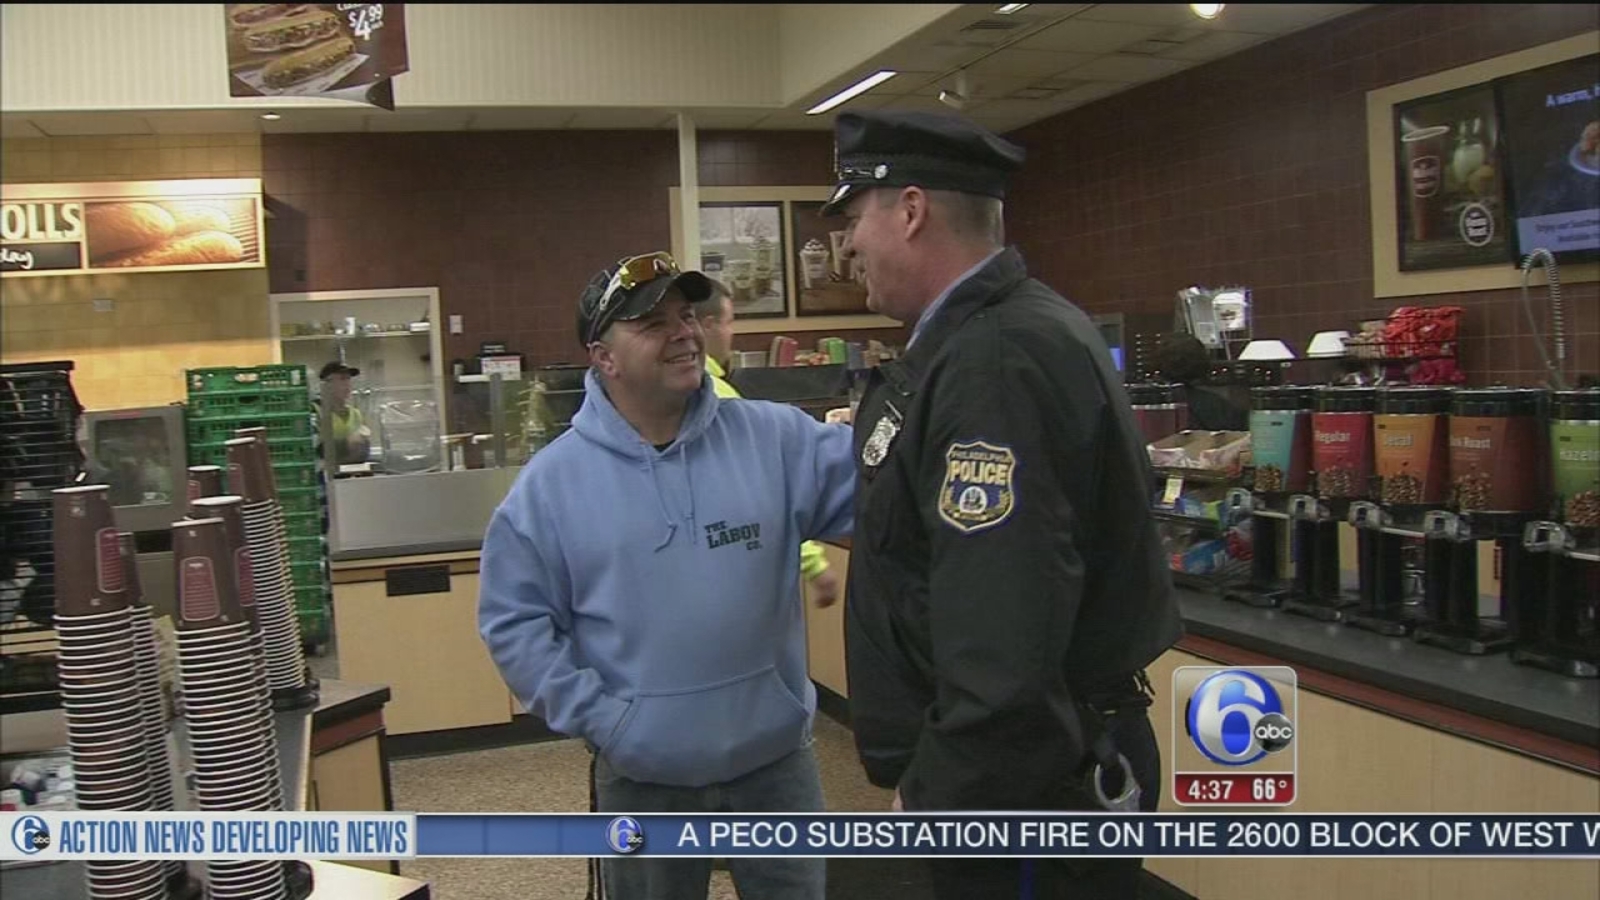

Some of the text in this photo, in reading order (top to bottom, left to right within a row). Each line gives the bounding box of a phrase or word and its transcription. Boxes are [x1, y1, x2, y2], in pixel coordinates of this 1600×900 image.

[1315, 431, 1350, 444] Regular
[950, 460, 1008, 486] POLICE
[705, 521, 727, 533] THE
[706, 523, 761, 549] LABOV
